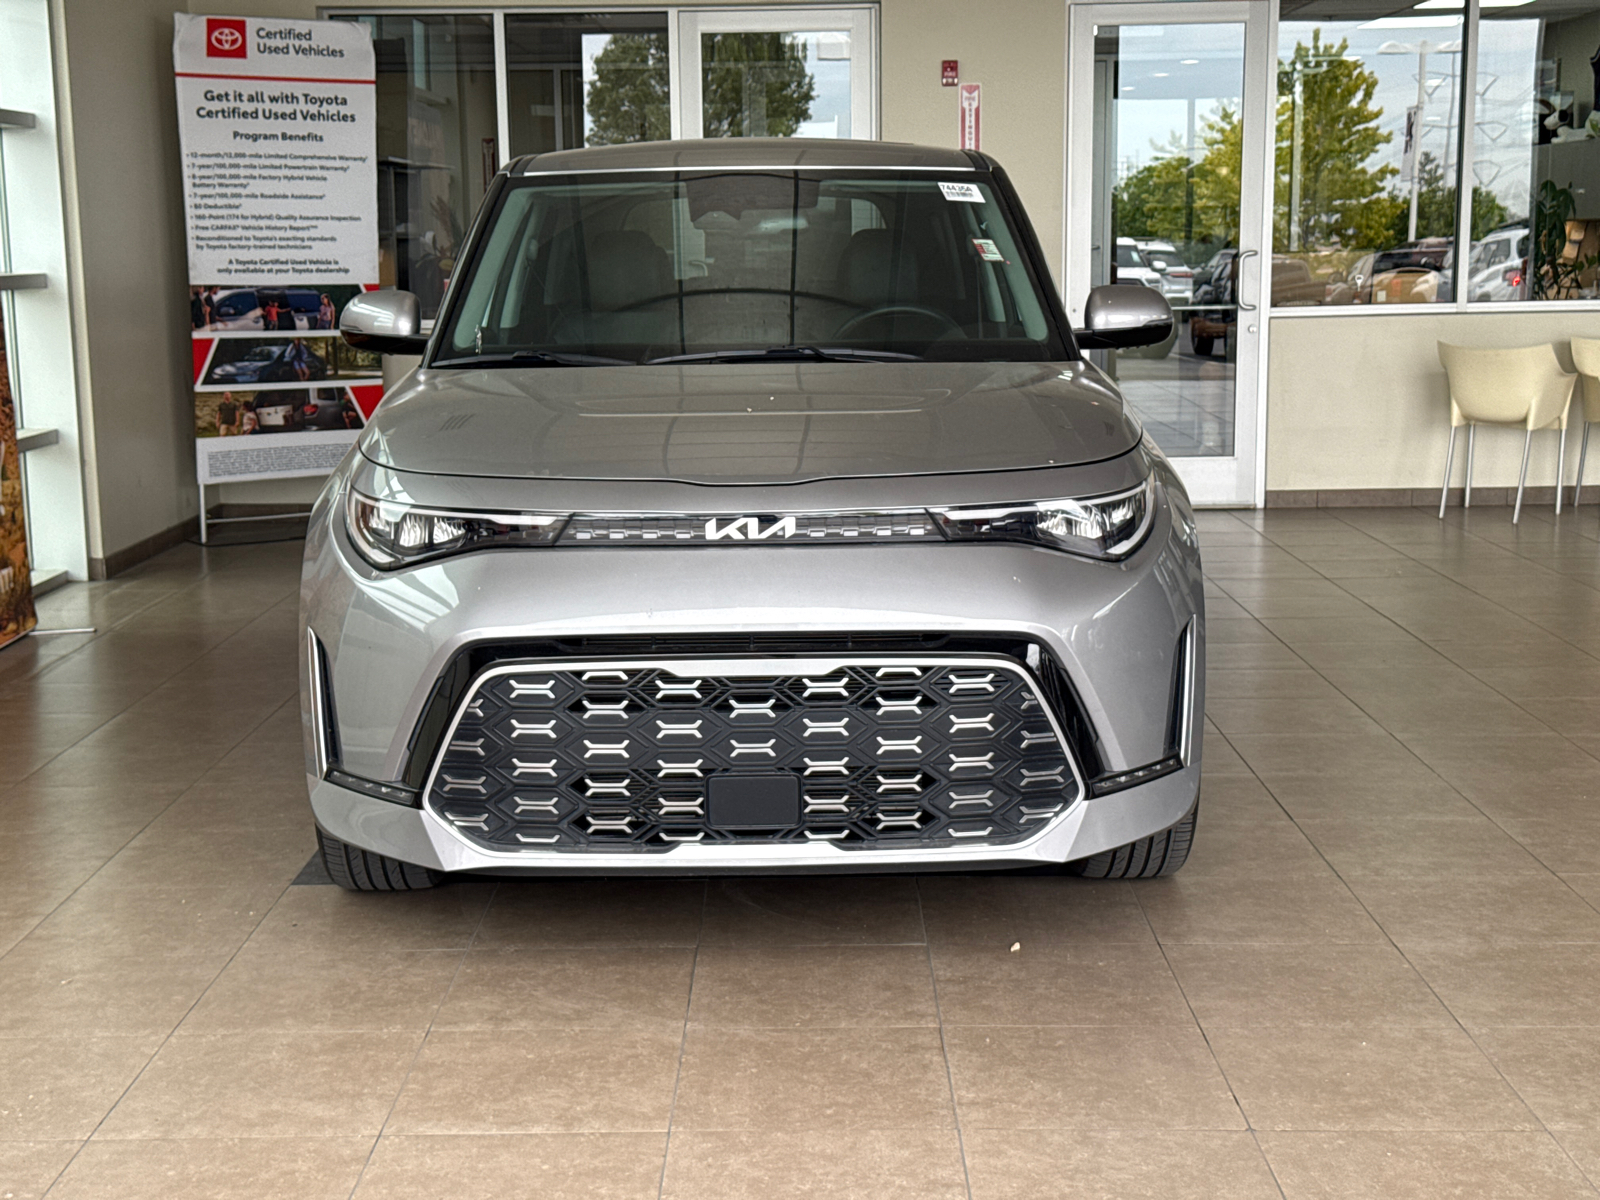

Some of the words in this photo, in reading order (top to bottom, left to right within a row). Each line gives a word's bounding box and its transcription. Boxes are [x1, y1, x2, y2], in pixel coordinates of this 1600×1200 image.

[256, 28, 312, 41] Certified
[257, 43, 289, 55] Used
[293, 43, 344, 57] Vehicles
[204, 90, 231, 102] Get
[234, 90, 244, 103] it
[247, 91, 265, 104] all
[268, 92, 299, 104] with
[302, 93, 347, 107] Toyota
[196, 107, 258, 120] Certified
[262, 109, 297, 120] Used
[300, 110, 355, 122] Vehicles
[233, 131, 278, 142] Program
[281, 132, 324, 142] Benefits
[705, 516, 796, 540] KIA
